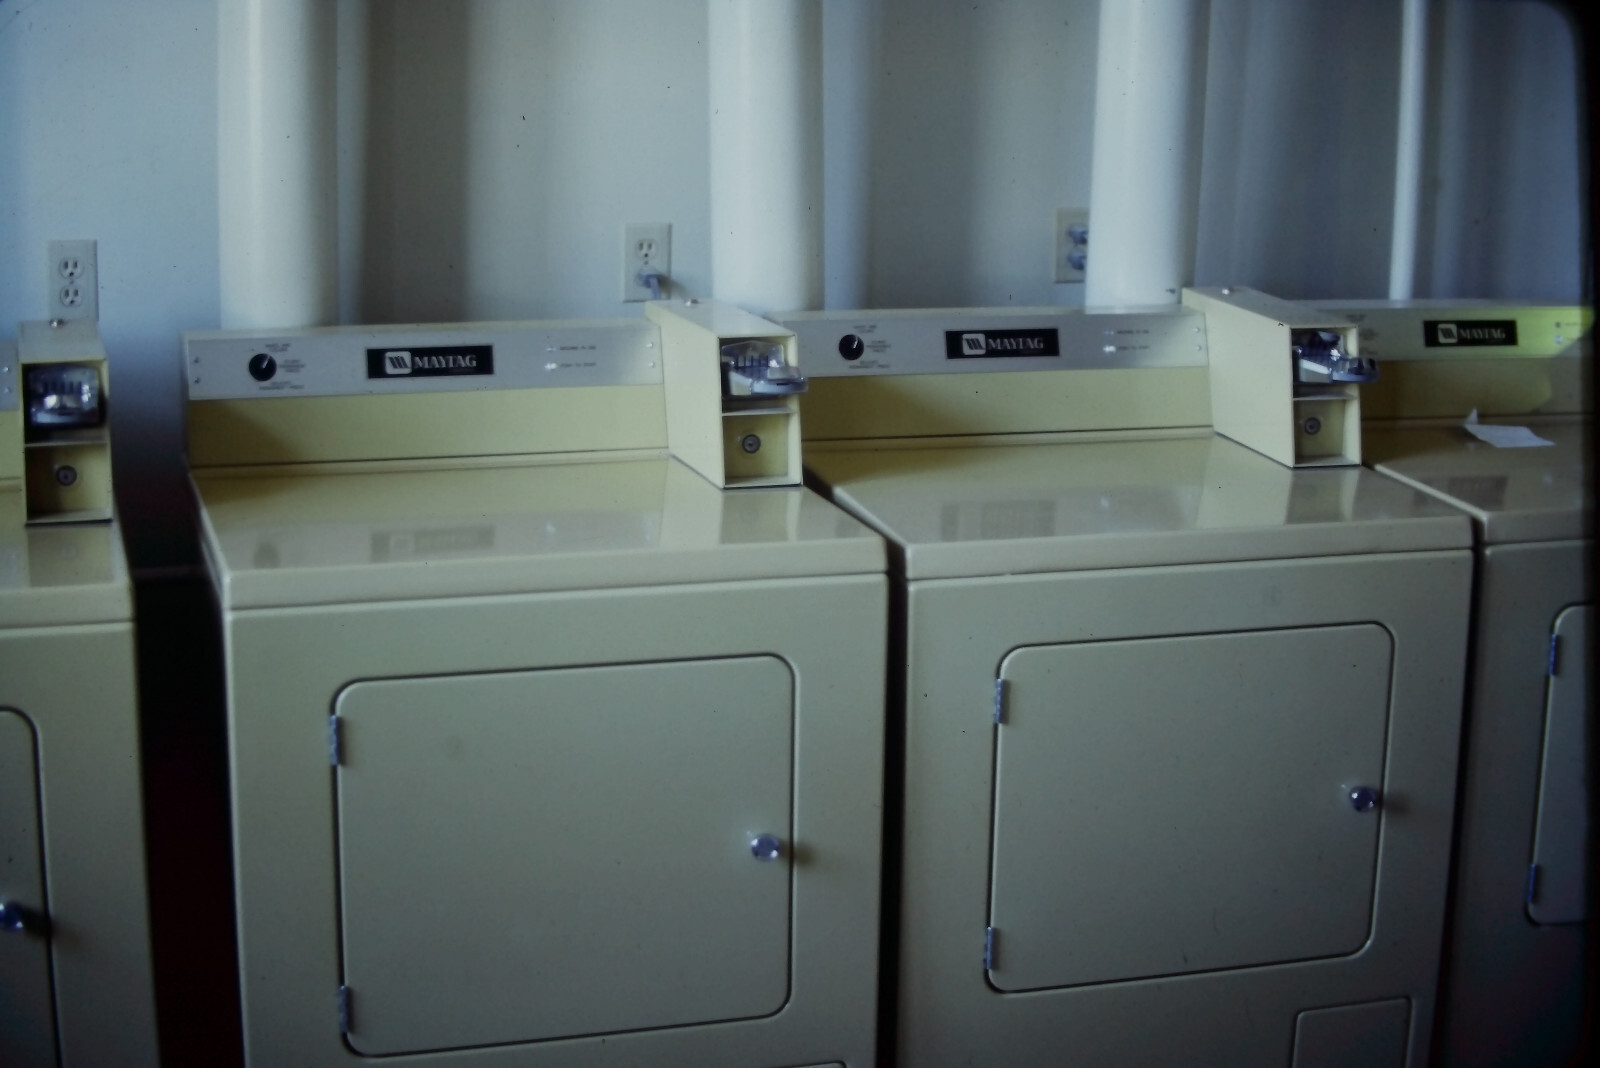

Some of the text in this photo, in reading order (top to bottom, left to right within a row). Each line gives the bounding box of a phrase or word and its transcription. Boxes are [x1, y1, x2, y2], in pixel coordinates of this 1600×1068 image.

[1458, 327, 1506, 340] MAYTAG
[987, 337, 1044, 350] MAYTAG
[414, 355, 477, 369] MAYTAG
